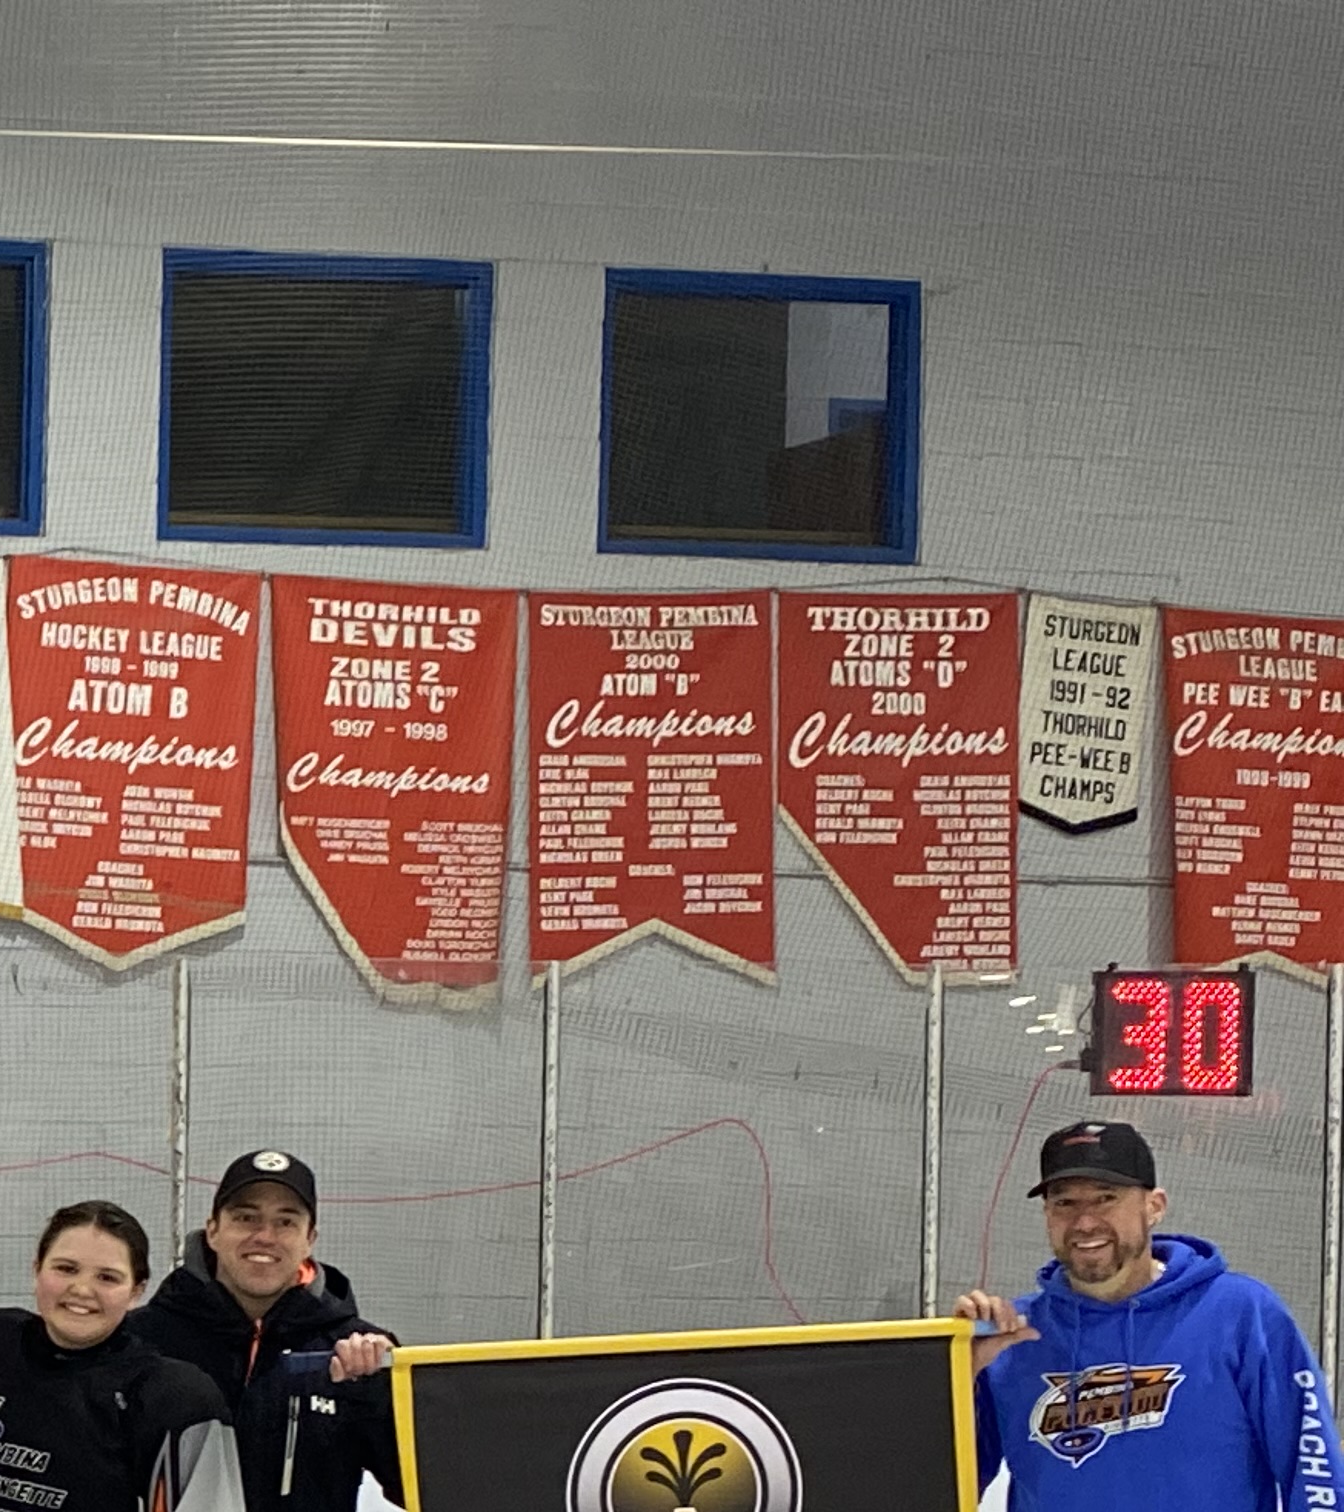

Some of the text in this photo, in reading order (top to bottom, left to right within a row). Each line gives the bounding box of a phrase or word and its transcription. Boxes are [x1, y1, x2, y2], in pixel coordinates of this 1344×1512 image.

[16, 576, 251, 636] STURGEON PEMBINA
[307, 597, 481, 625] THORHILD
[540, 603, 759, 627] STURGEON PEMBINA
[806, 606, 990, 632] THORHILD
[40, 621, 223, 662] HOCKEY LEAGUE
[309, 617, 477, 653] DEVILS
[610, 629, 694, 651] LEAGUE
[844, 633, 956, 658] ZONE 2
[1044, 614, 1141, 647] STURGEON
[1171, 626, 1280, 660] STURGEON
[330, 655, 441, 684] ZONE 2
[624, 653, 680, 670] 2000
[830, 660, 912, 687] ATOMS
[1052, 648, 1127, 678] LEAGUE
[1239, 654, 1318, 682] LEAGUE
[67, 678, 189, 719] ATOM B
[324, 679, 411, 710] ATOMS
[599, 672, 658, 697] ATOM
[1183, 682, 1270, 709] PEE WEE
[871, 691, 926, 716] 2000
[330, 719, 448, 742] 1997 1998
[545, 699, 757, 749] Champions
[1041, 709, 1127, 741] THORHILD
[15, 715, 239, 775] Champions
[788, 711, 1009, 769] Champions
[1029, 741, 1131, 775] PEE-WEE B
[285, 752, 490, 798] Champions
[1039, 774, 1116, 805] CHAMPS
[1109, 979, 1241, 1090] 30
